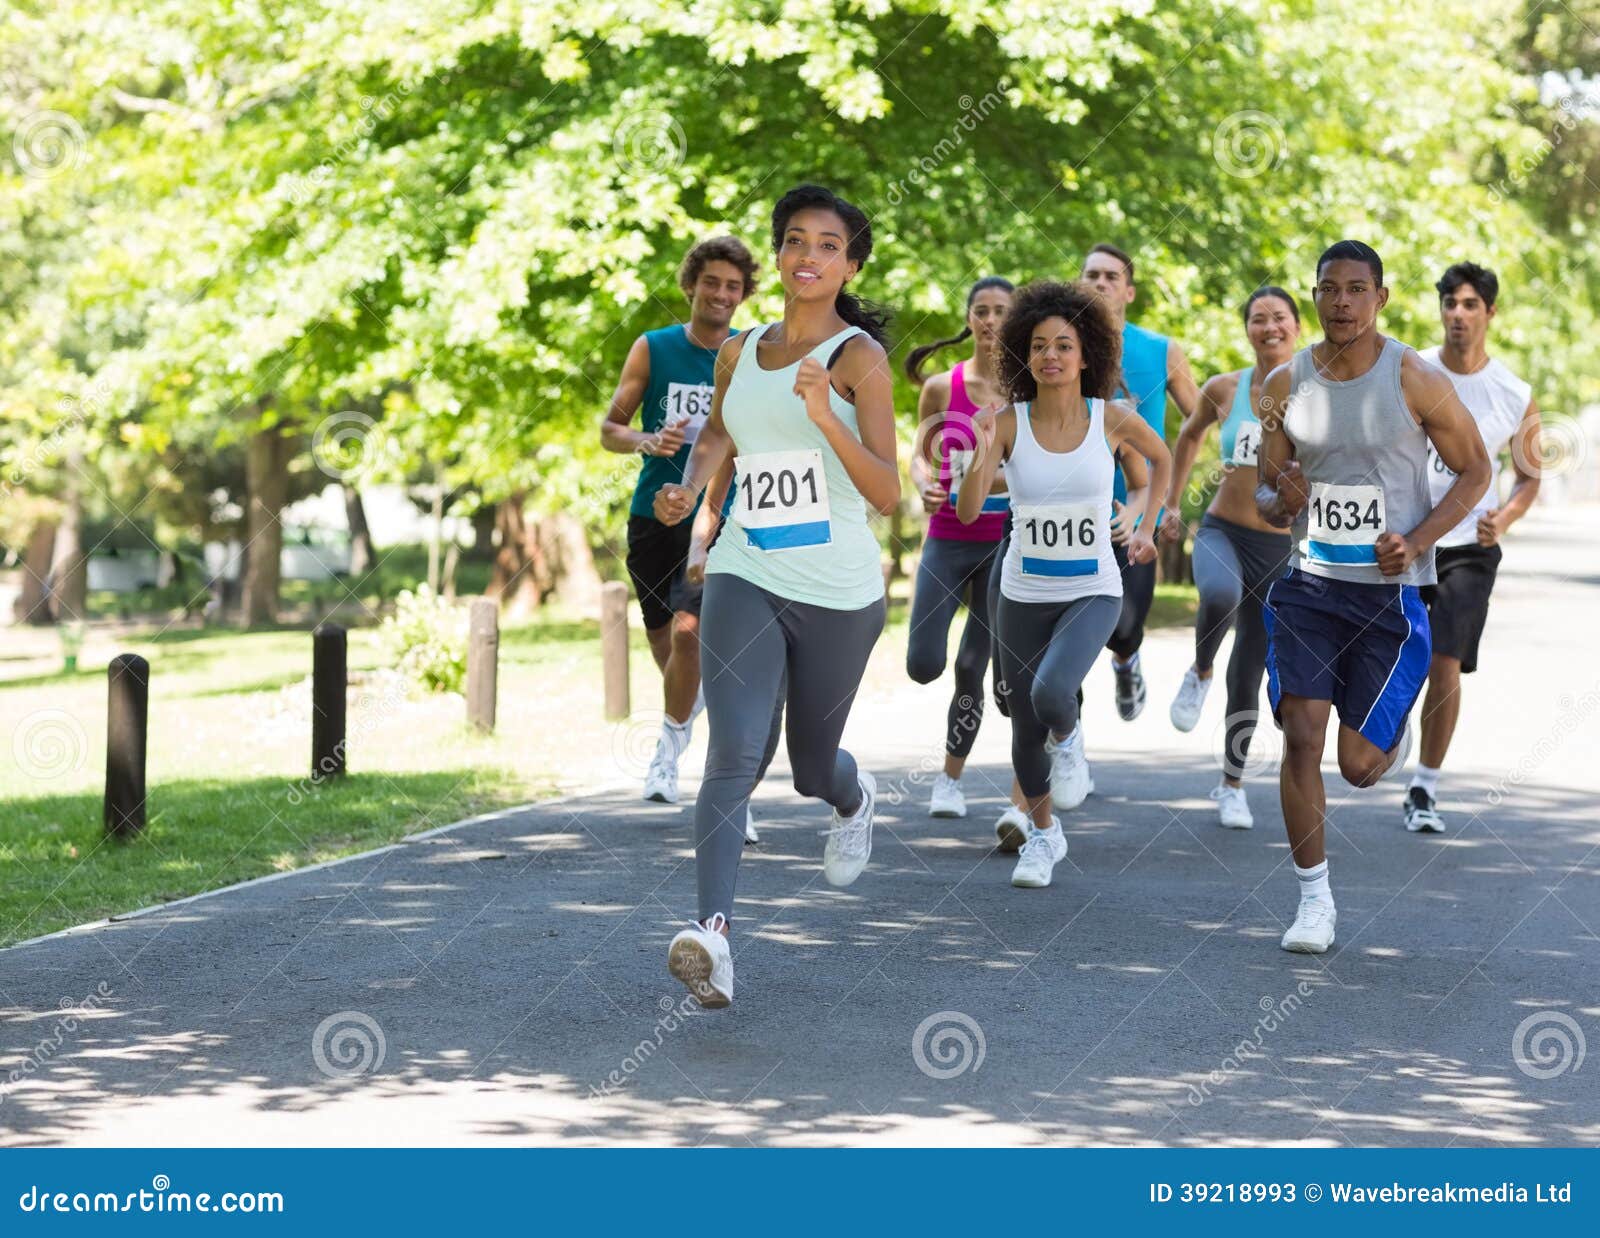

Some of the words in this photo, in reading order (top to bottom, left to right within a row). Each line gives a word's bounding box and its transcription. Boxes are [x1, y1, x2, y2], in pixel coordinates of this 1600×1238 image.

[741, 467, 818, 511] 1201
[1312, 497, 1382, 531] 1634
[1025, 518, 1096, 547] 1016
